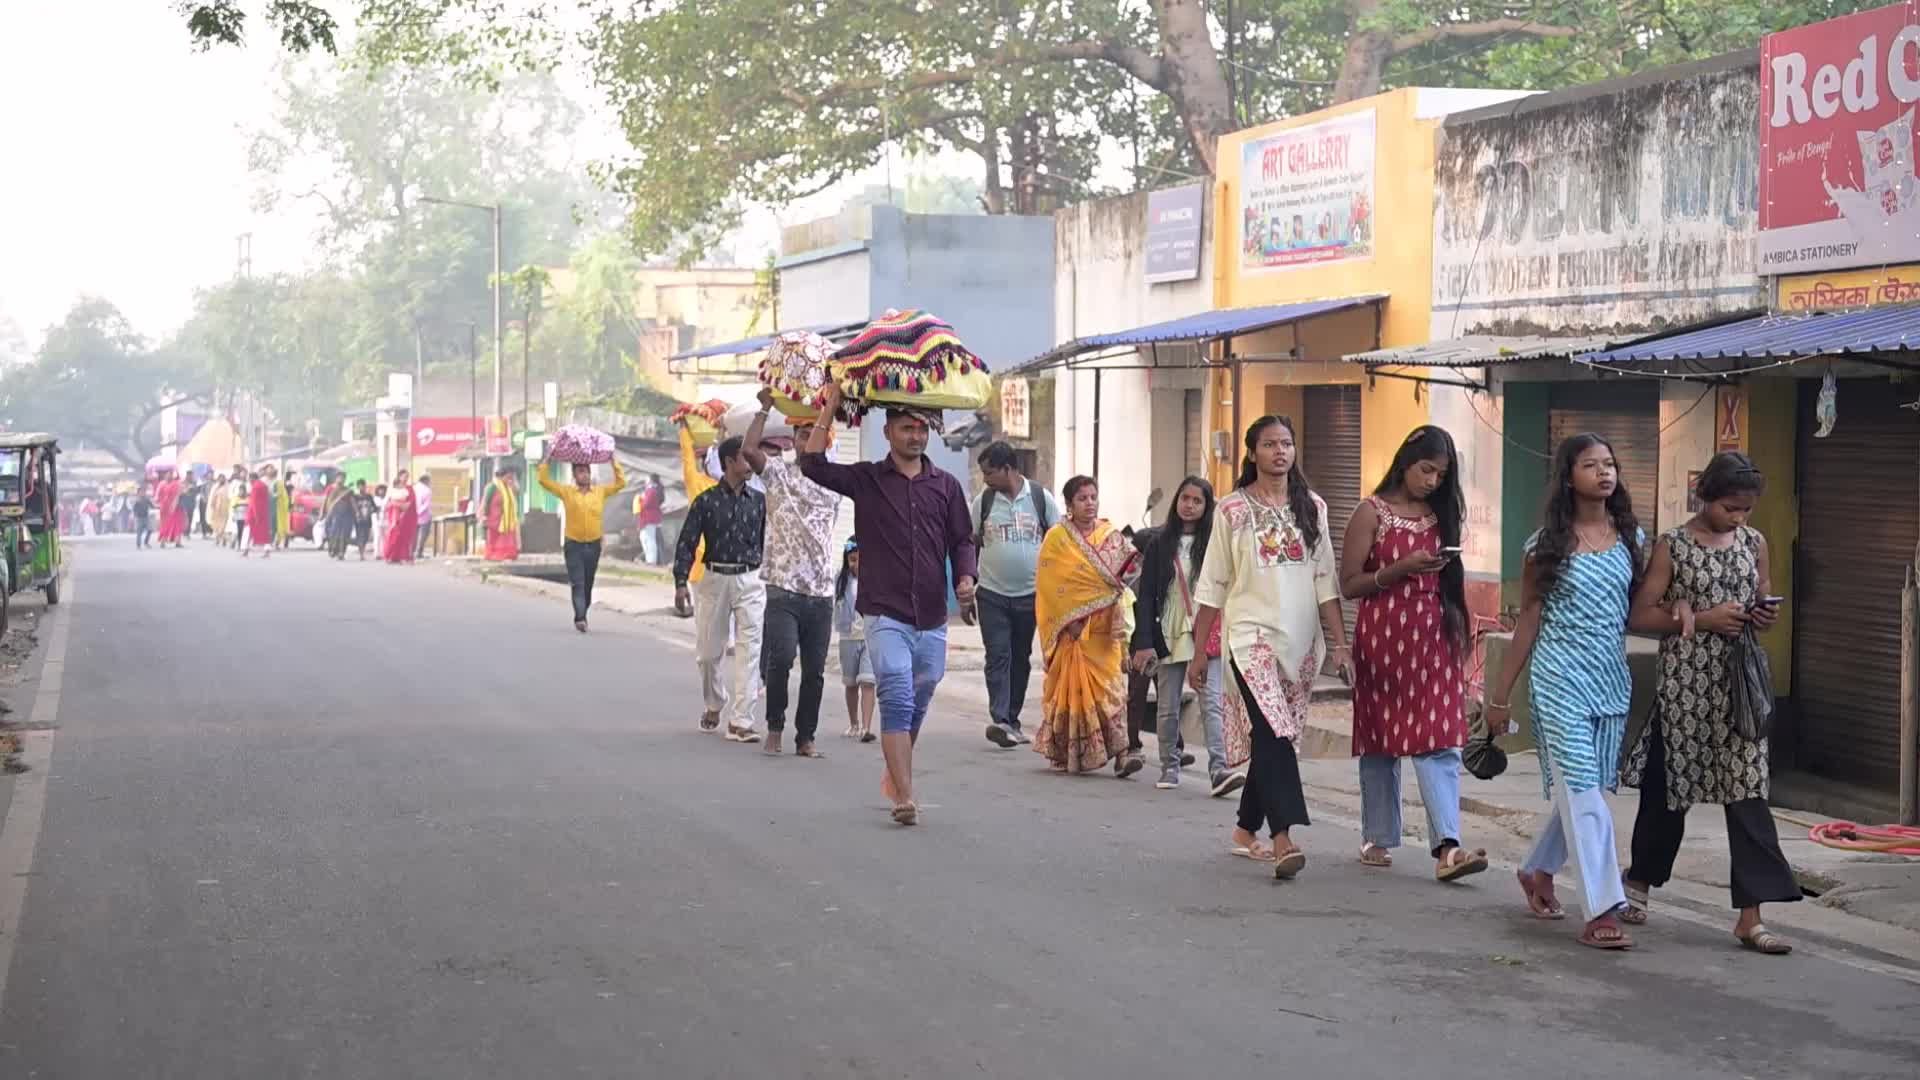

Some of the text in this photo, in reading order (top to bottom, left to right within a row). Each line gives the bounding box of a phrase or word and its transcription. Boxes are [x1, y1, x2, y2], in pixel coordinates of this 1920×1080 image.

[1770, 34, 1880, 128] Red
[1262, 146, 1285, 181] ART
[1763, 241, 1859, 265] AMBICA STATIONERY
